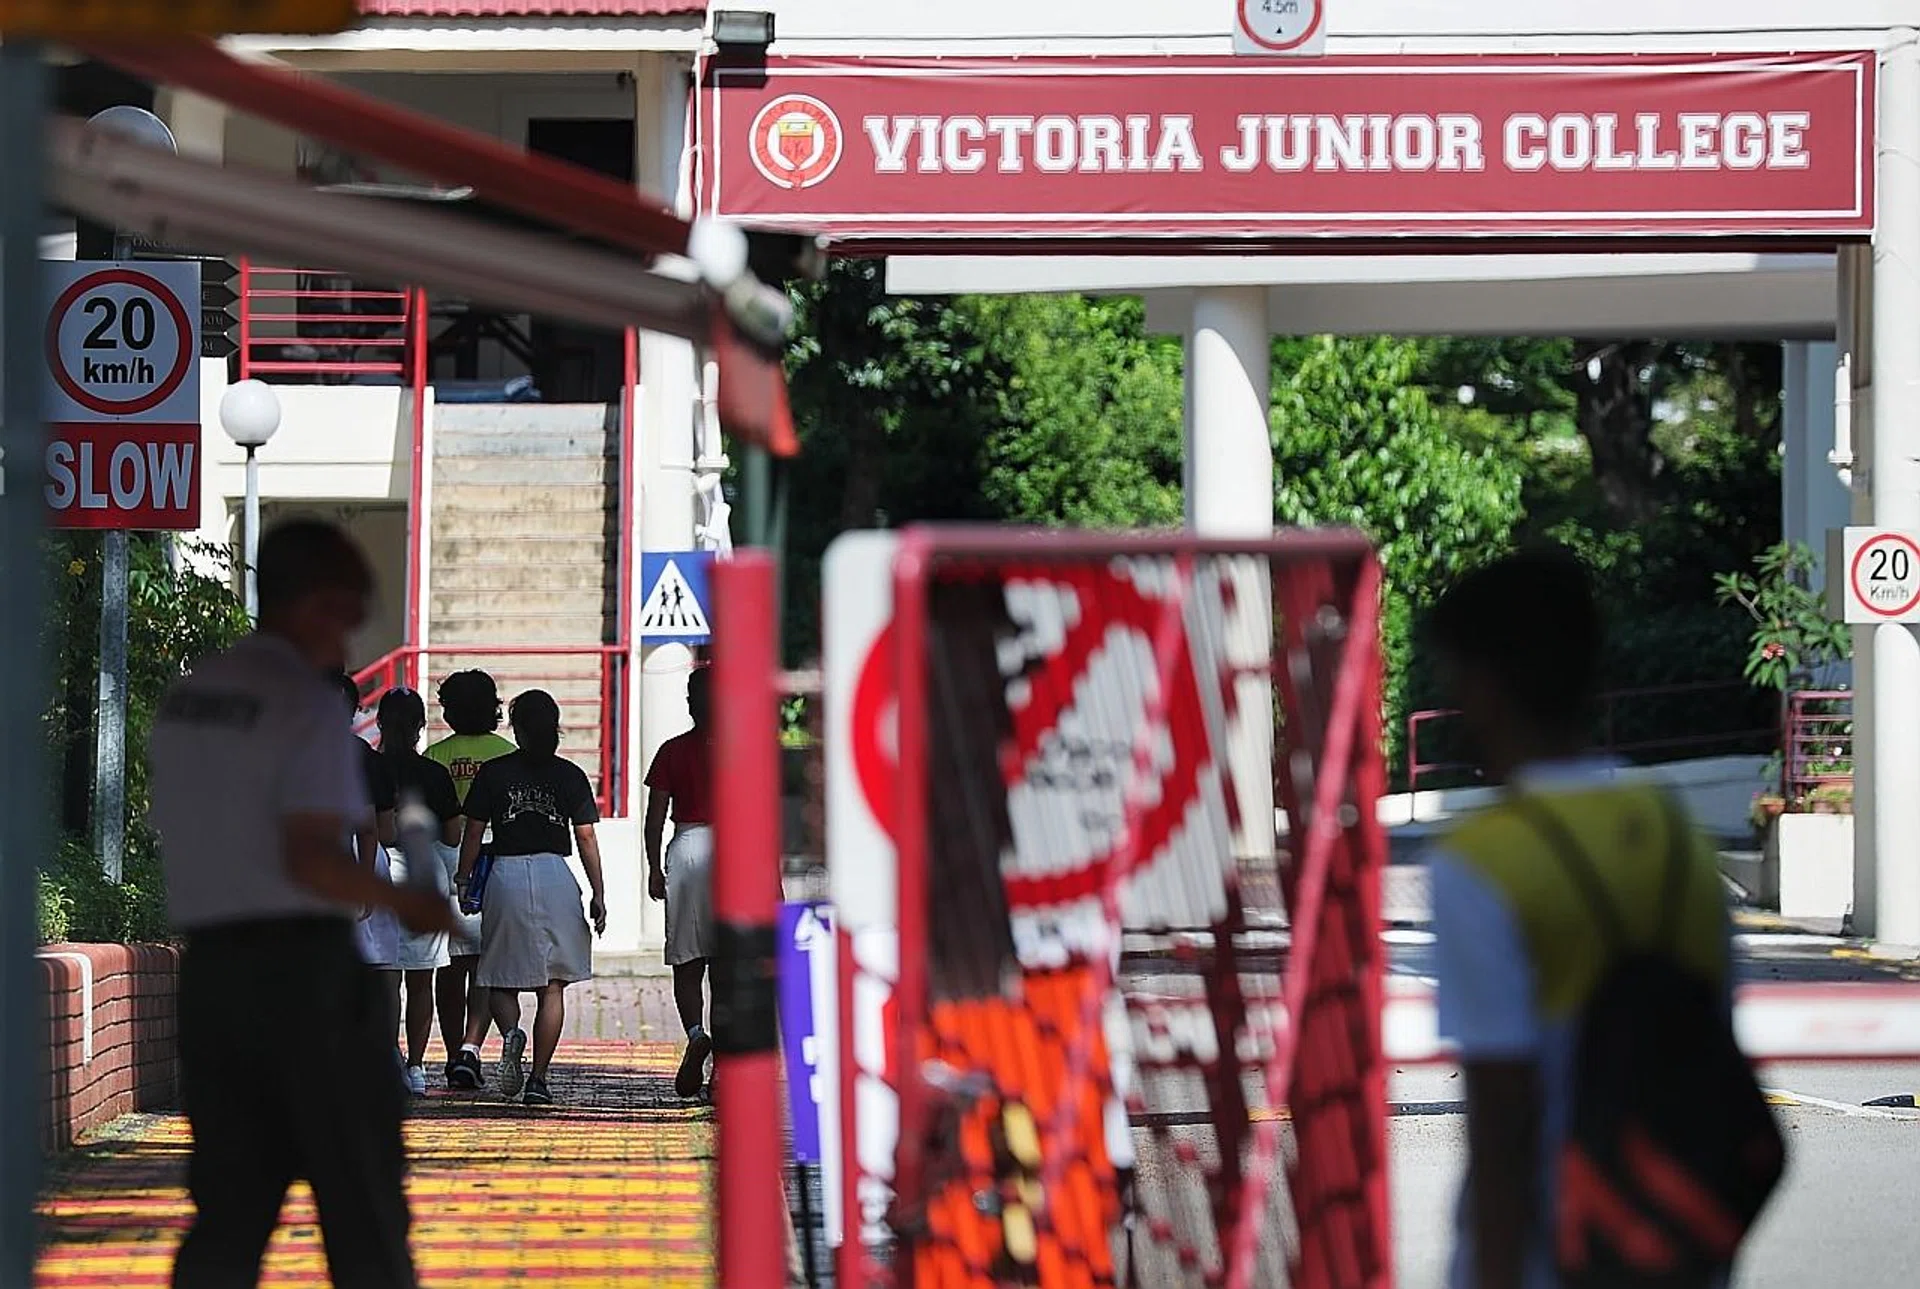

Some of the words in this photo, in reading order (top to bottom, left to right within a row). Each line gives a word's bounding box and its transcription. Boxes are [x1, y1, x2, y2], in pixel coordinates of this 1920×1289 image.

[863, 114, 1203, 174] VICTORIA
[1220, 112, 1486, 172] JUNIOR
[1503, 111, 1810, 171] COLLEGE
[82, 296, 156, 351] 20
[83, 356, 155, 384] km/h
[45, 440, 195, 510] SLOW
[1870, 548, 1909, 581] 20
